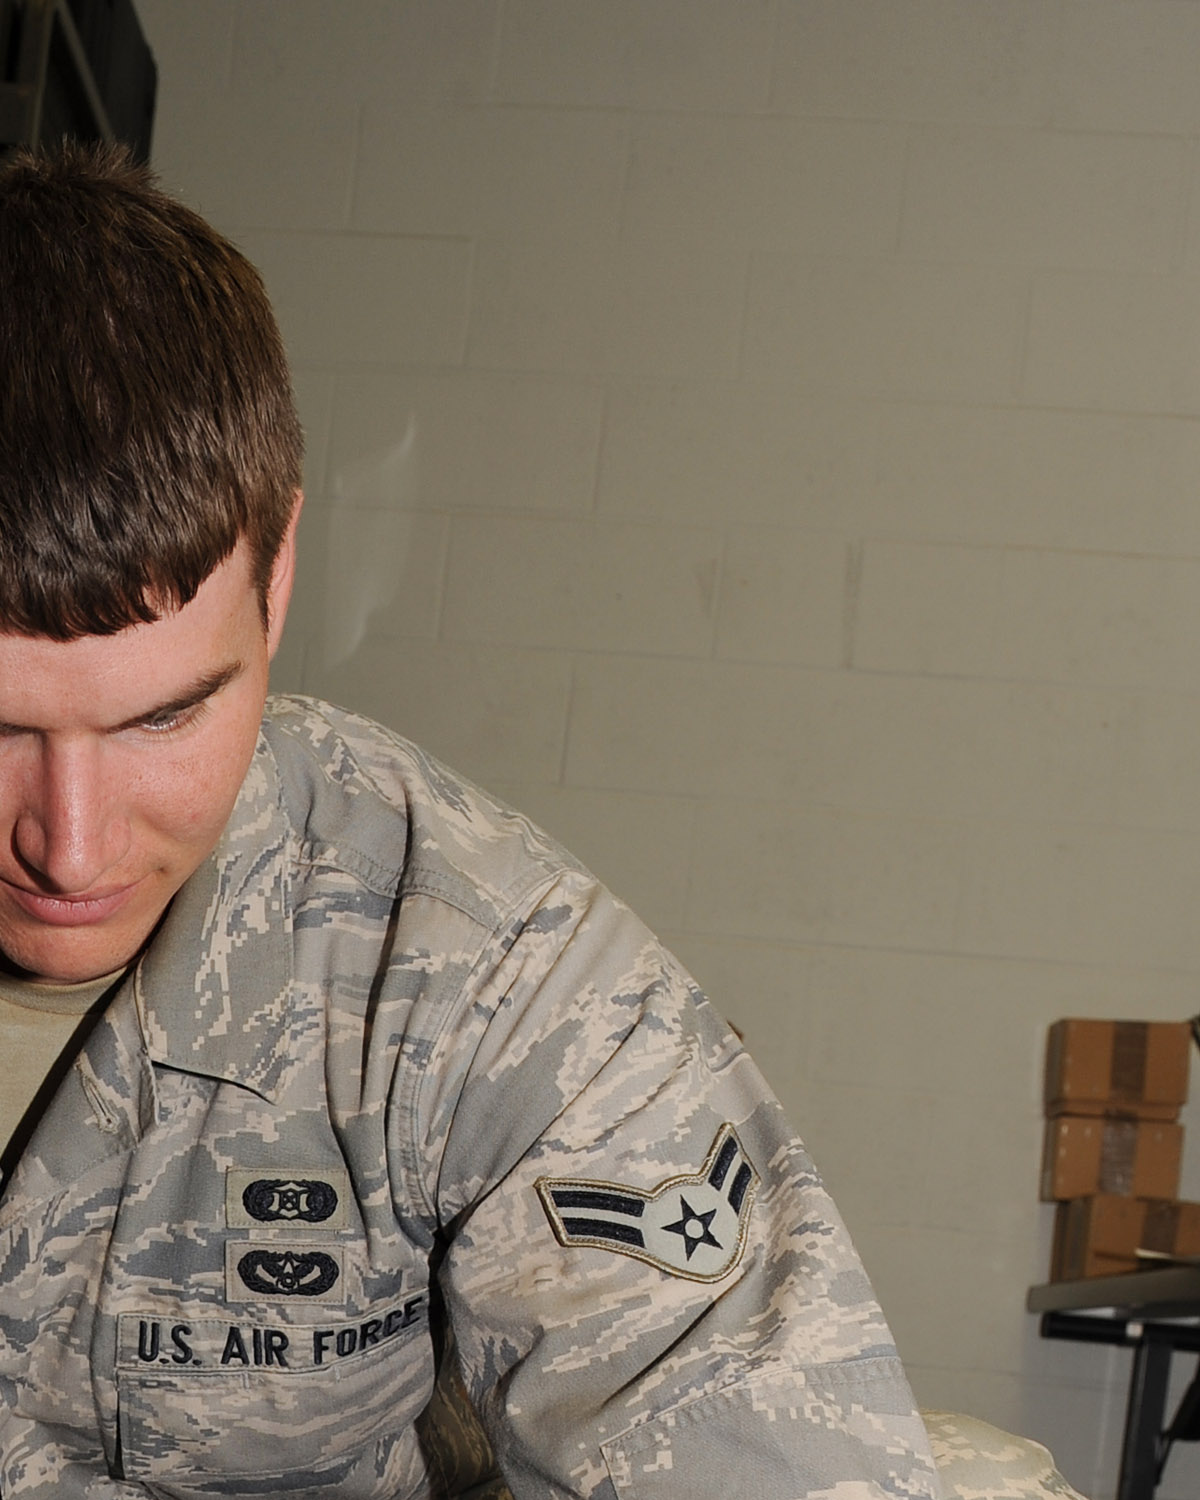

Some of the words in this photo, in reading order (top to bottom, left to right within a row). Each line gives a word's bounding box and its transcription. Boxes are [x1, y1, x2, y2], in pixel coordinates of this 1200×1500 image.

[138, 1320, 202, 1366] U.S.
[220, 1326, 290, 1367] AIR
[313, 1297, 423, 1365] FORCE
